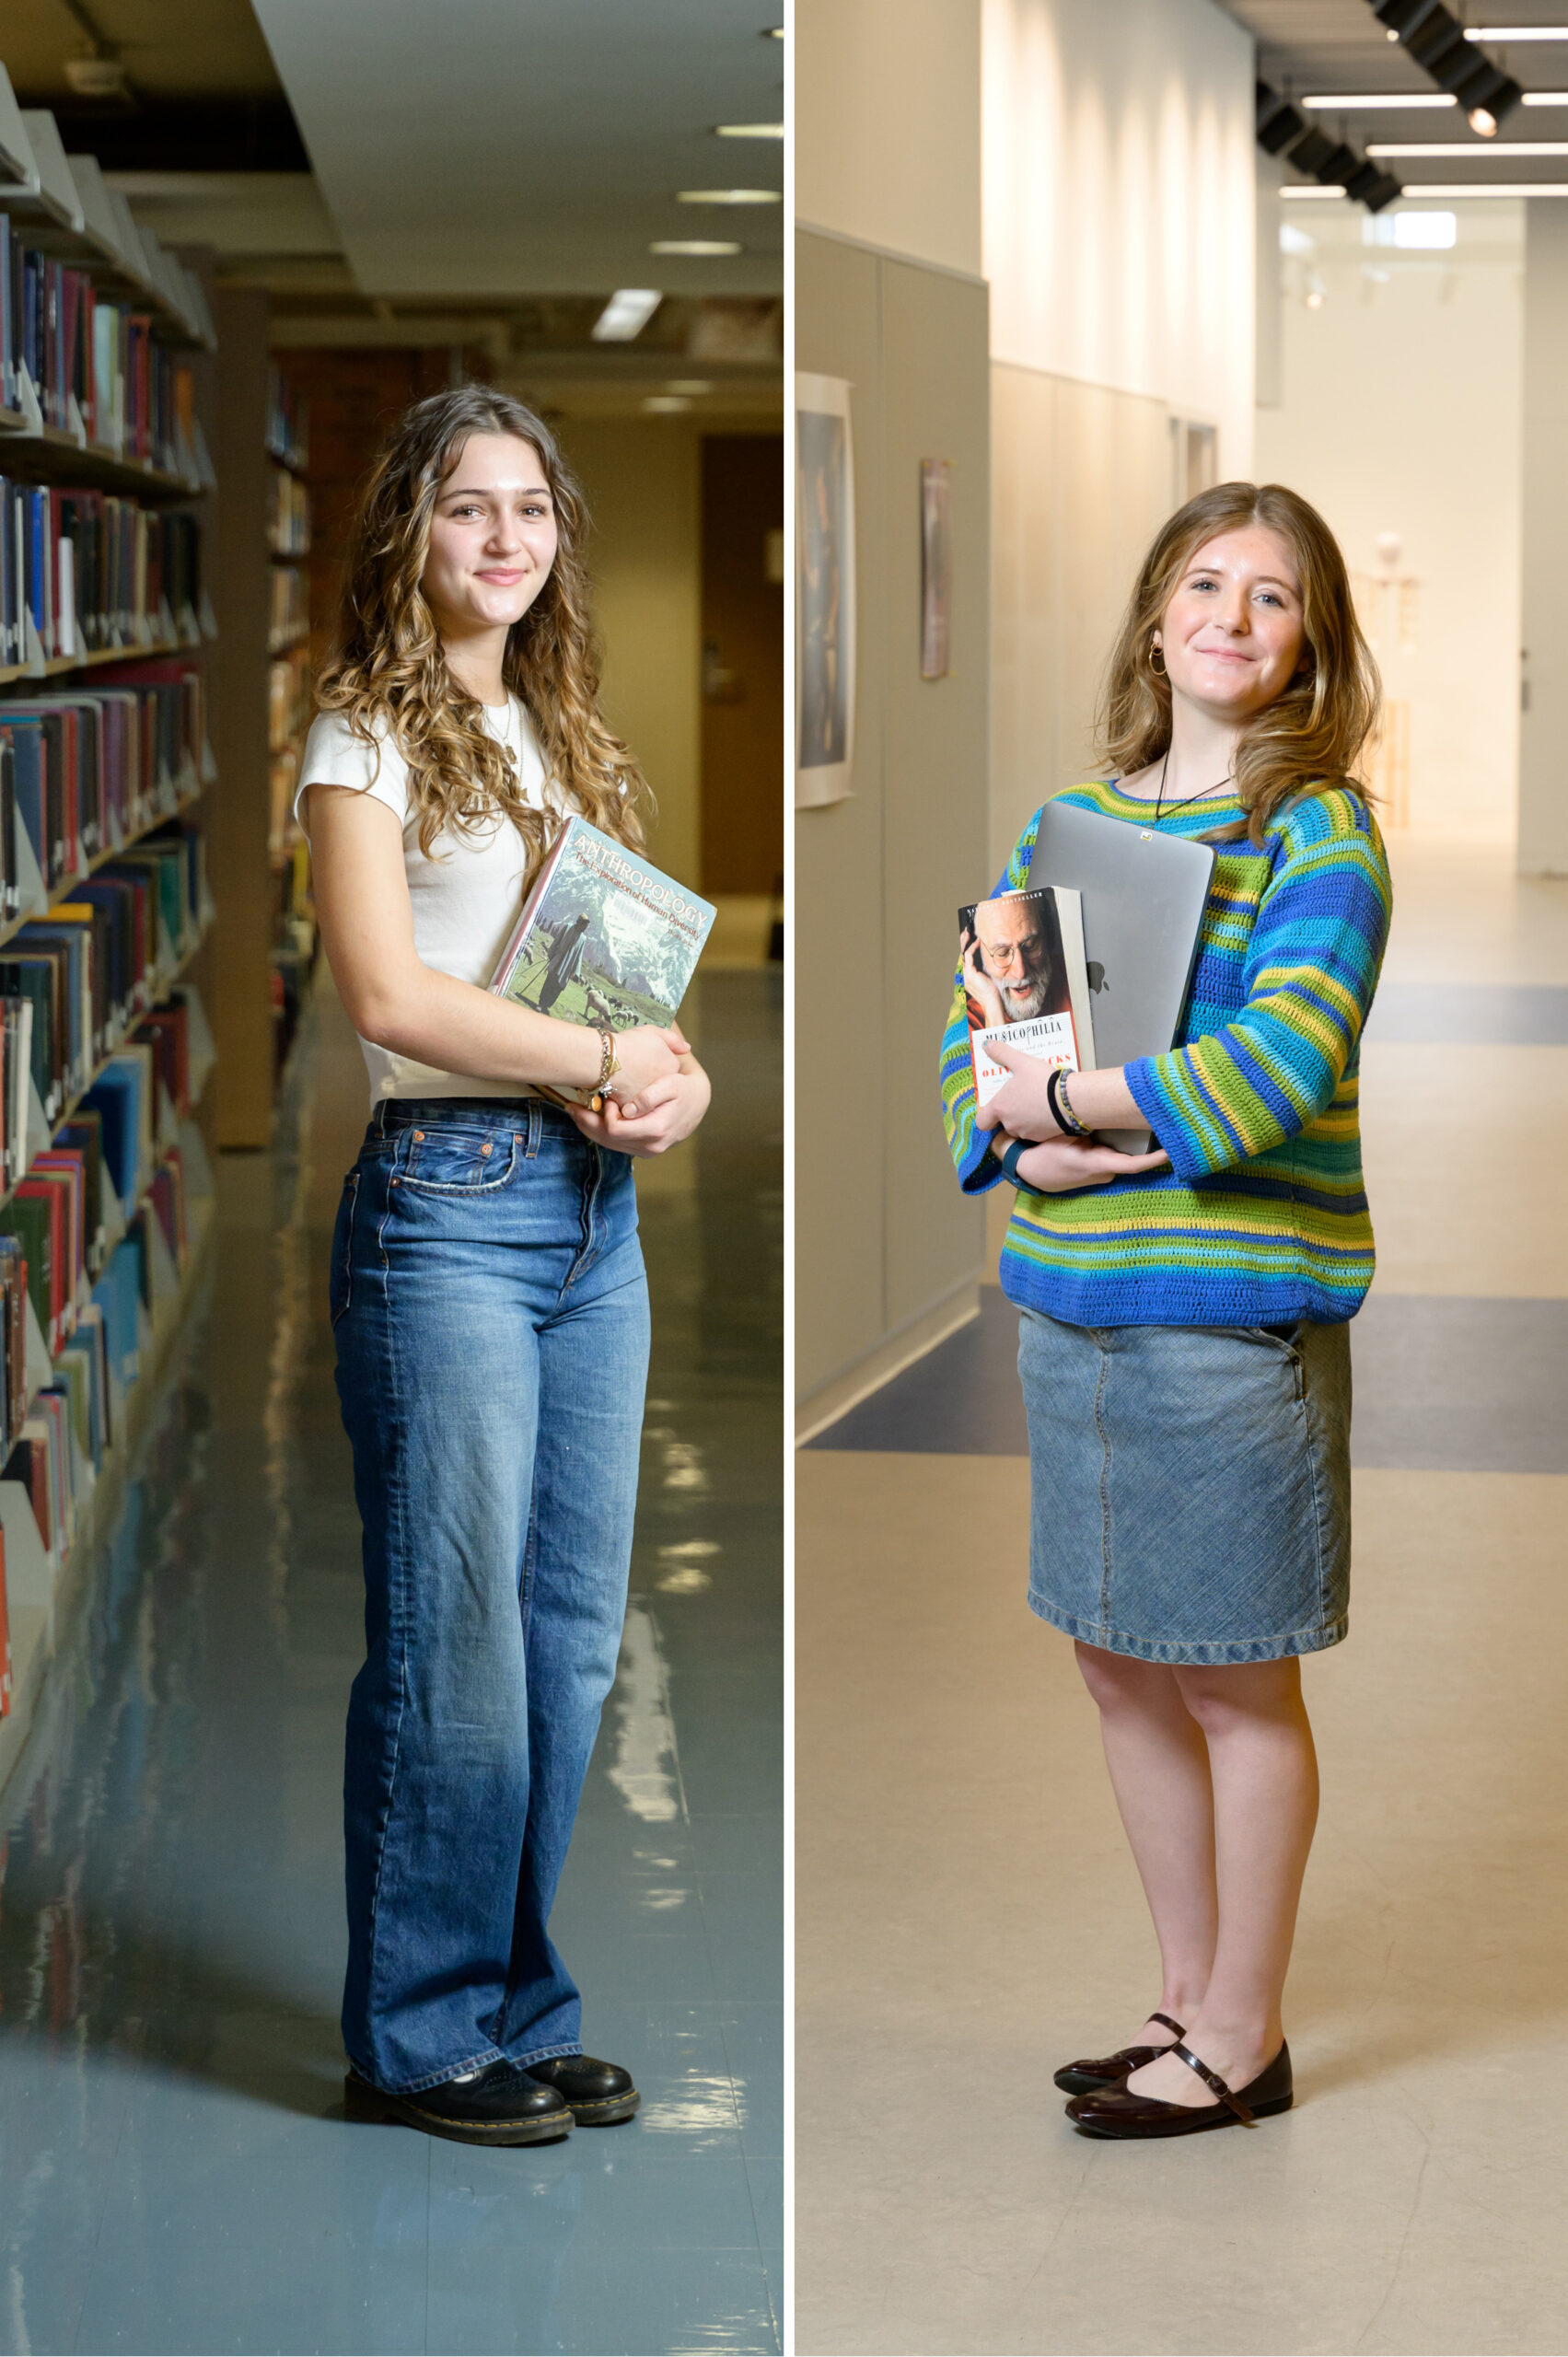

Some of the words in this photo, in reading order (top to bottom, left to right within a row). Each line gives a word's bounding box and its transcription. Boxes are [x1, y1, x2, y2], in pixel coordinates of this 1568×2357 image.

[574, 833, 708, 928] ANTHROPOLOGY
[575, 851, 589, 867] The
[589, 861, 633, 896] Exploration
[633, 891, 642, 901] of
[641, 894, 668, 919] Human
[668, 912, 702, 941] Diversity
[1001, 891, 1043, 906] BESTSELLER
[981, 1065, 1010, 1078] OLIV
[1048, 1054, 1072, 1065] CKS
